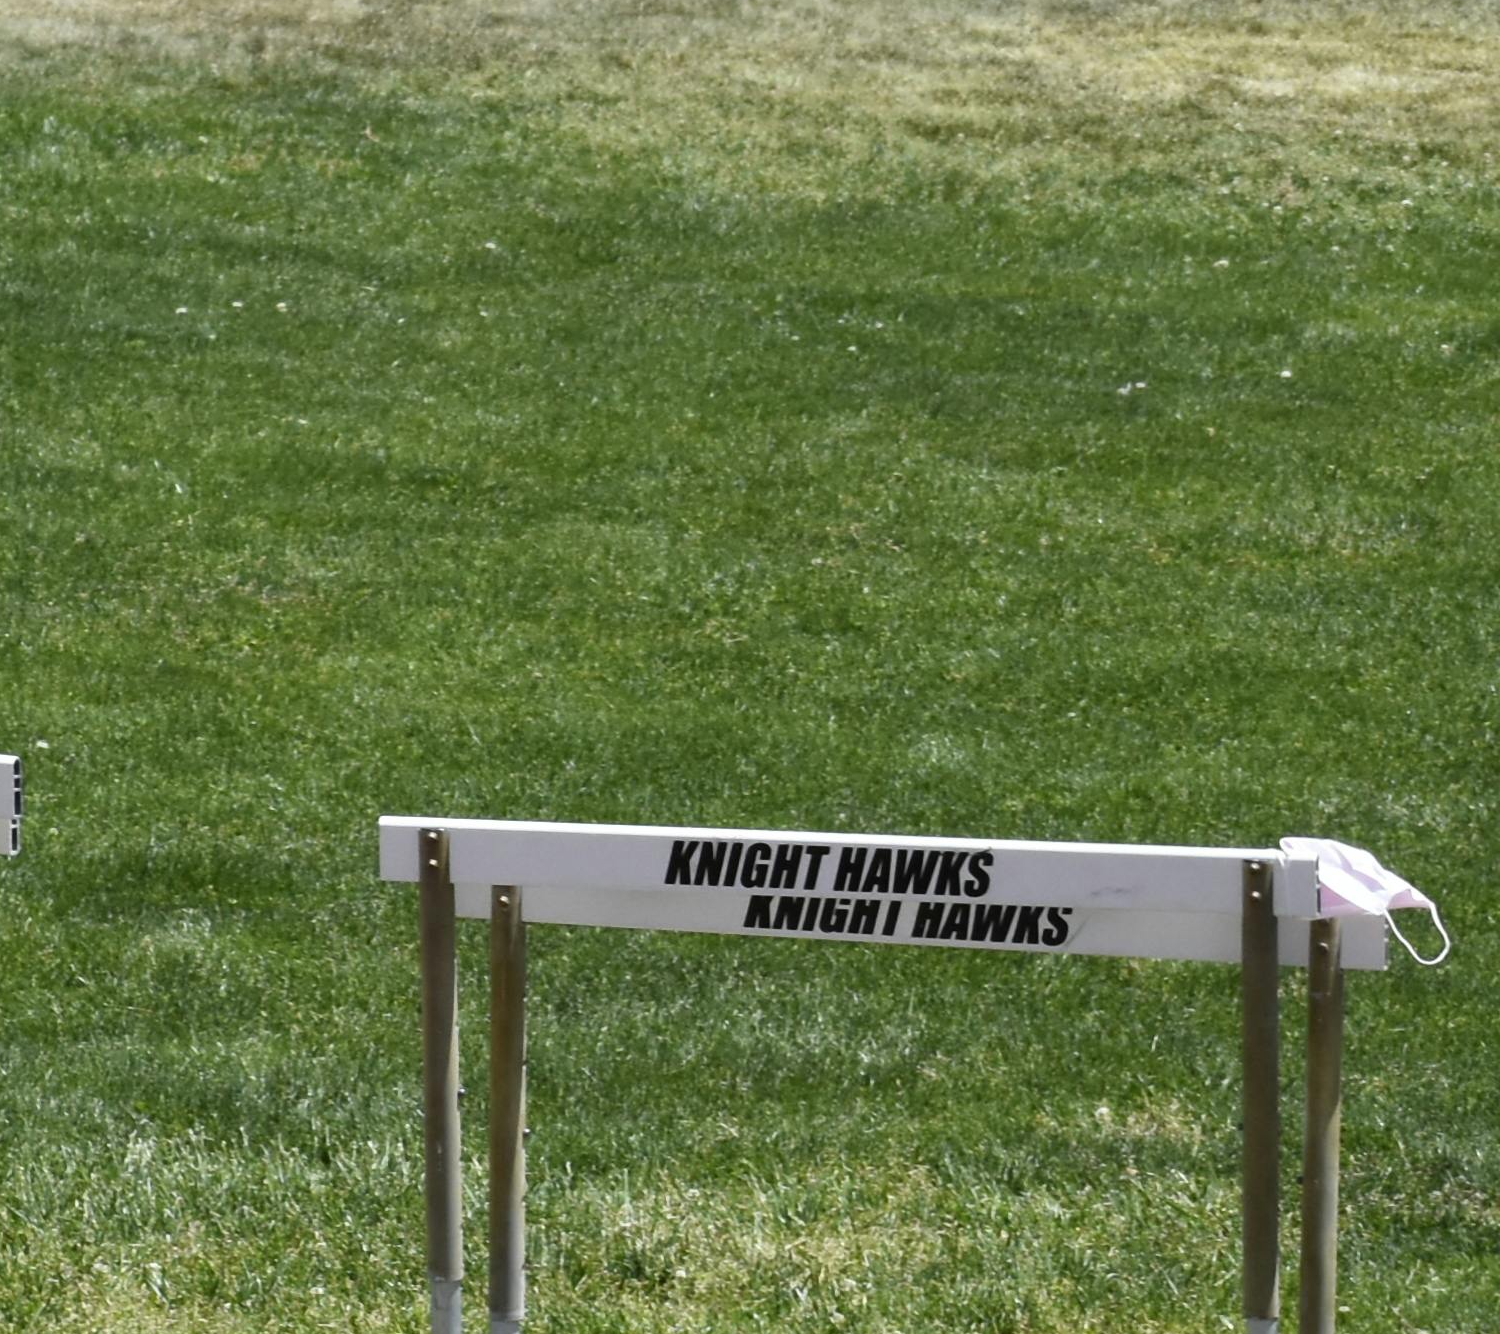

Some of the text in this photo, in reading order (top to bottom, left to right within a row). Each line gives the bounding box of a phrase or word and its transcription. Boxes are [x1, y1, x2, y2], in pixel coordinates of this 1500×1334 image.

[664, 840, 994, 898] KNIGHT HAWKS
[911, 902, 1073, 947] HAWKS
